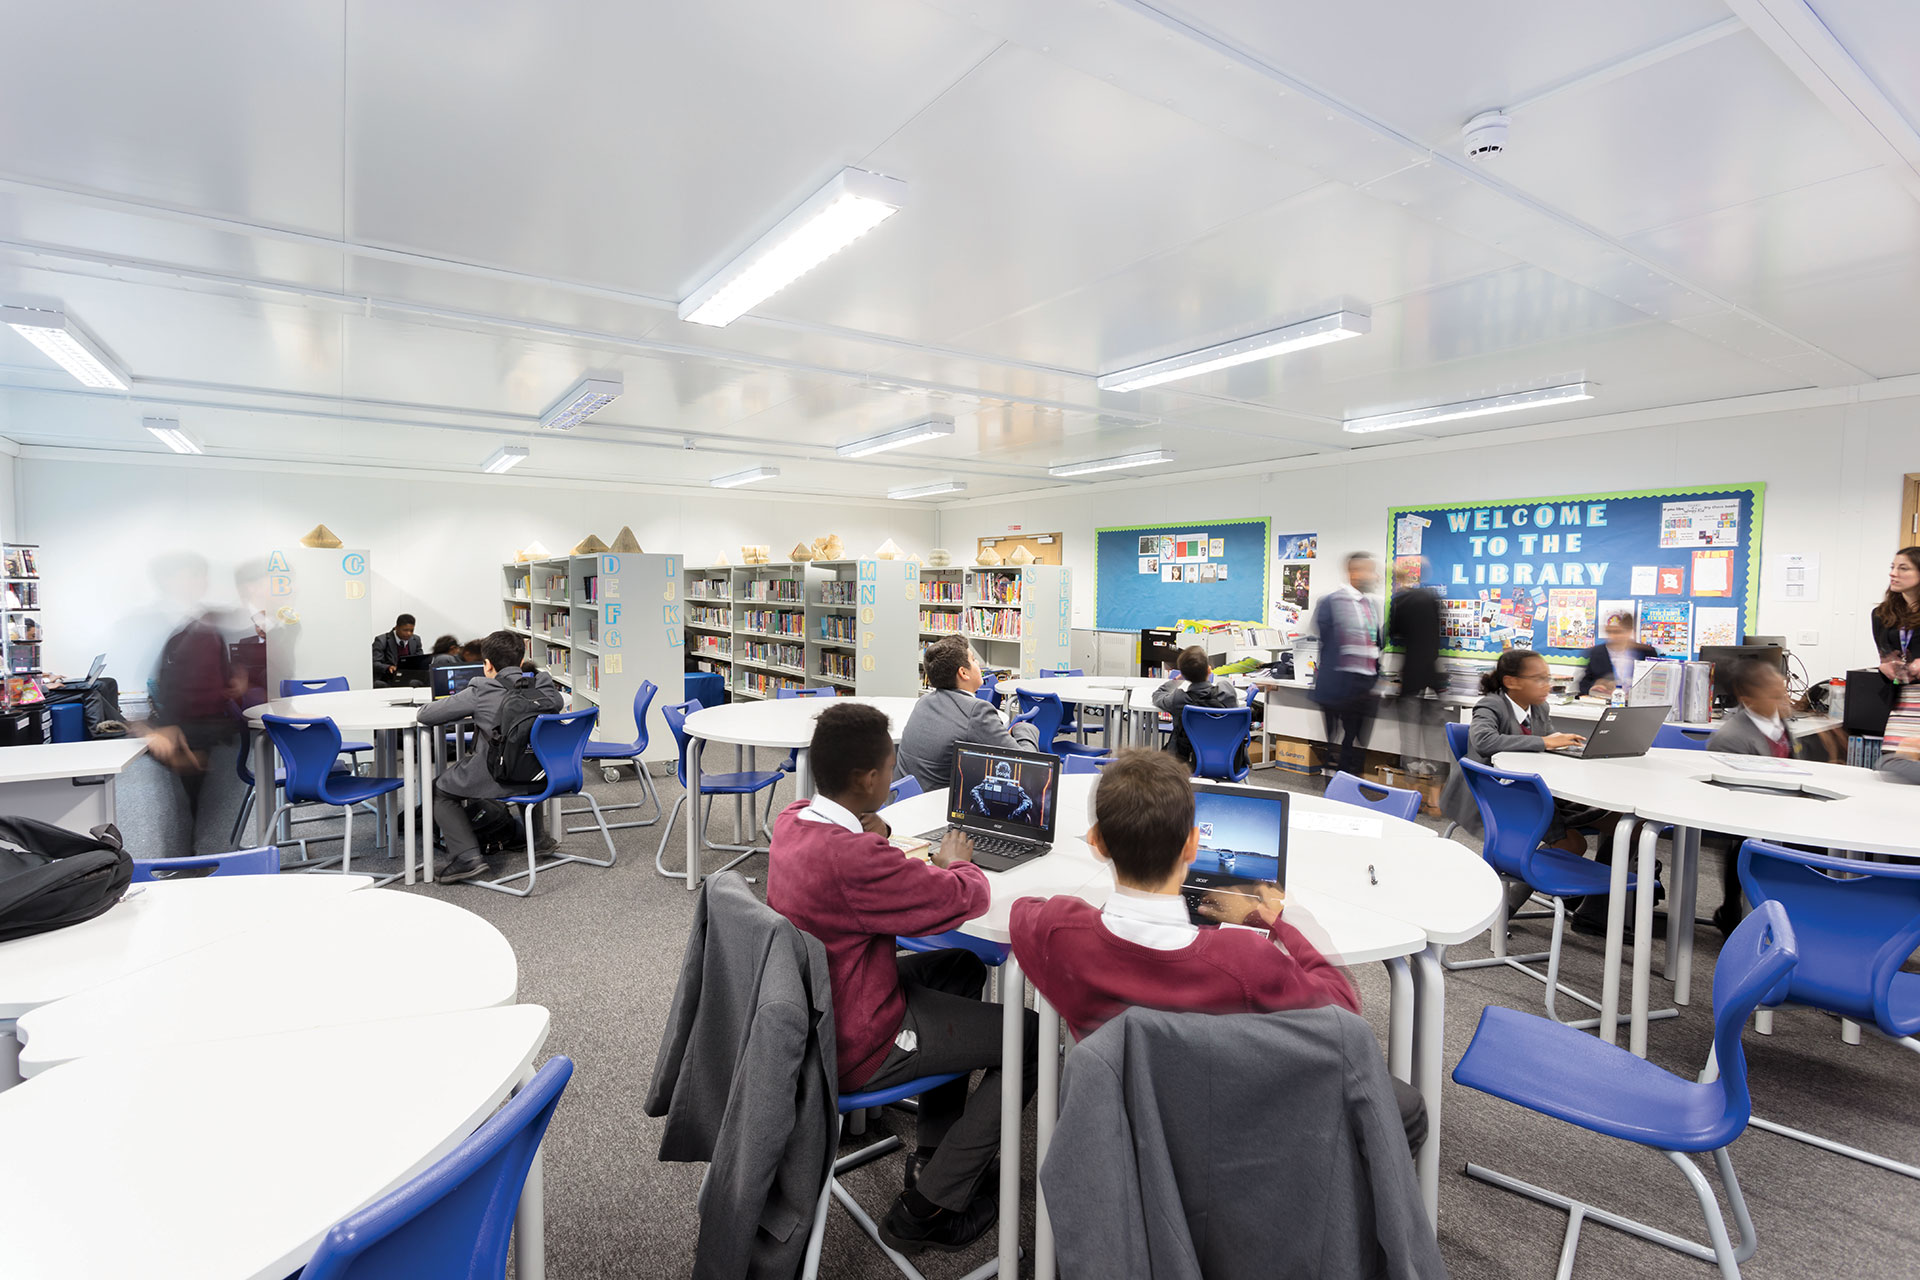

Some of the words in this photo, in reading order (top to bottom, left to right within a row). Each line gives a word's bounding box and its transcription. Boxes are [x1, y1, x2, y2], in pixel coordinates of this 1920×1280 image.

[1447, 504, 1607, 532] WELCOME
[1469, 535, 1508, 557] TO
[1518, 533, 1582, 555] THE
[1452, 563, 1609, 585] LIBRARY
